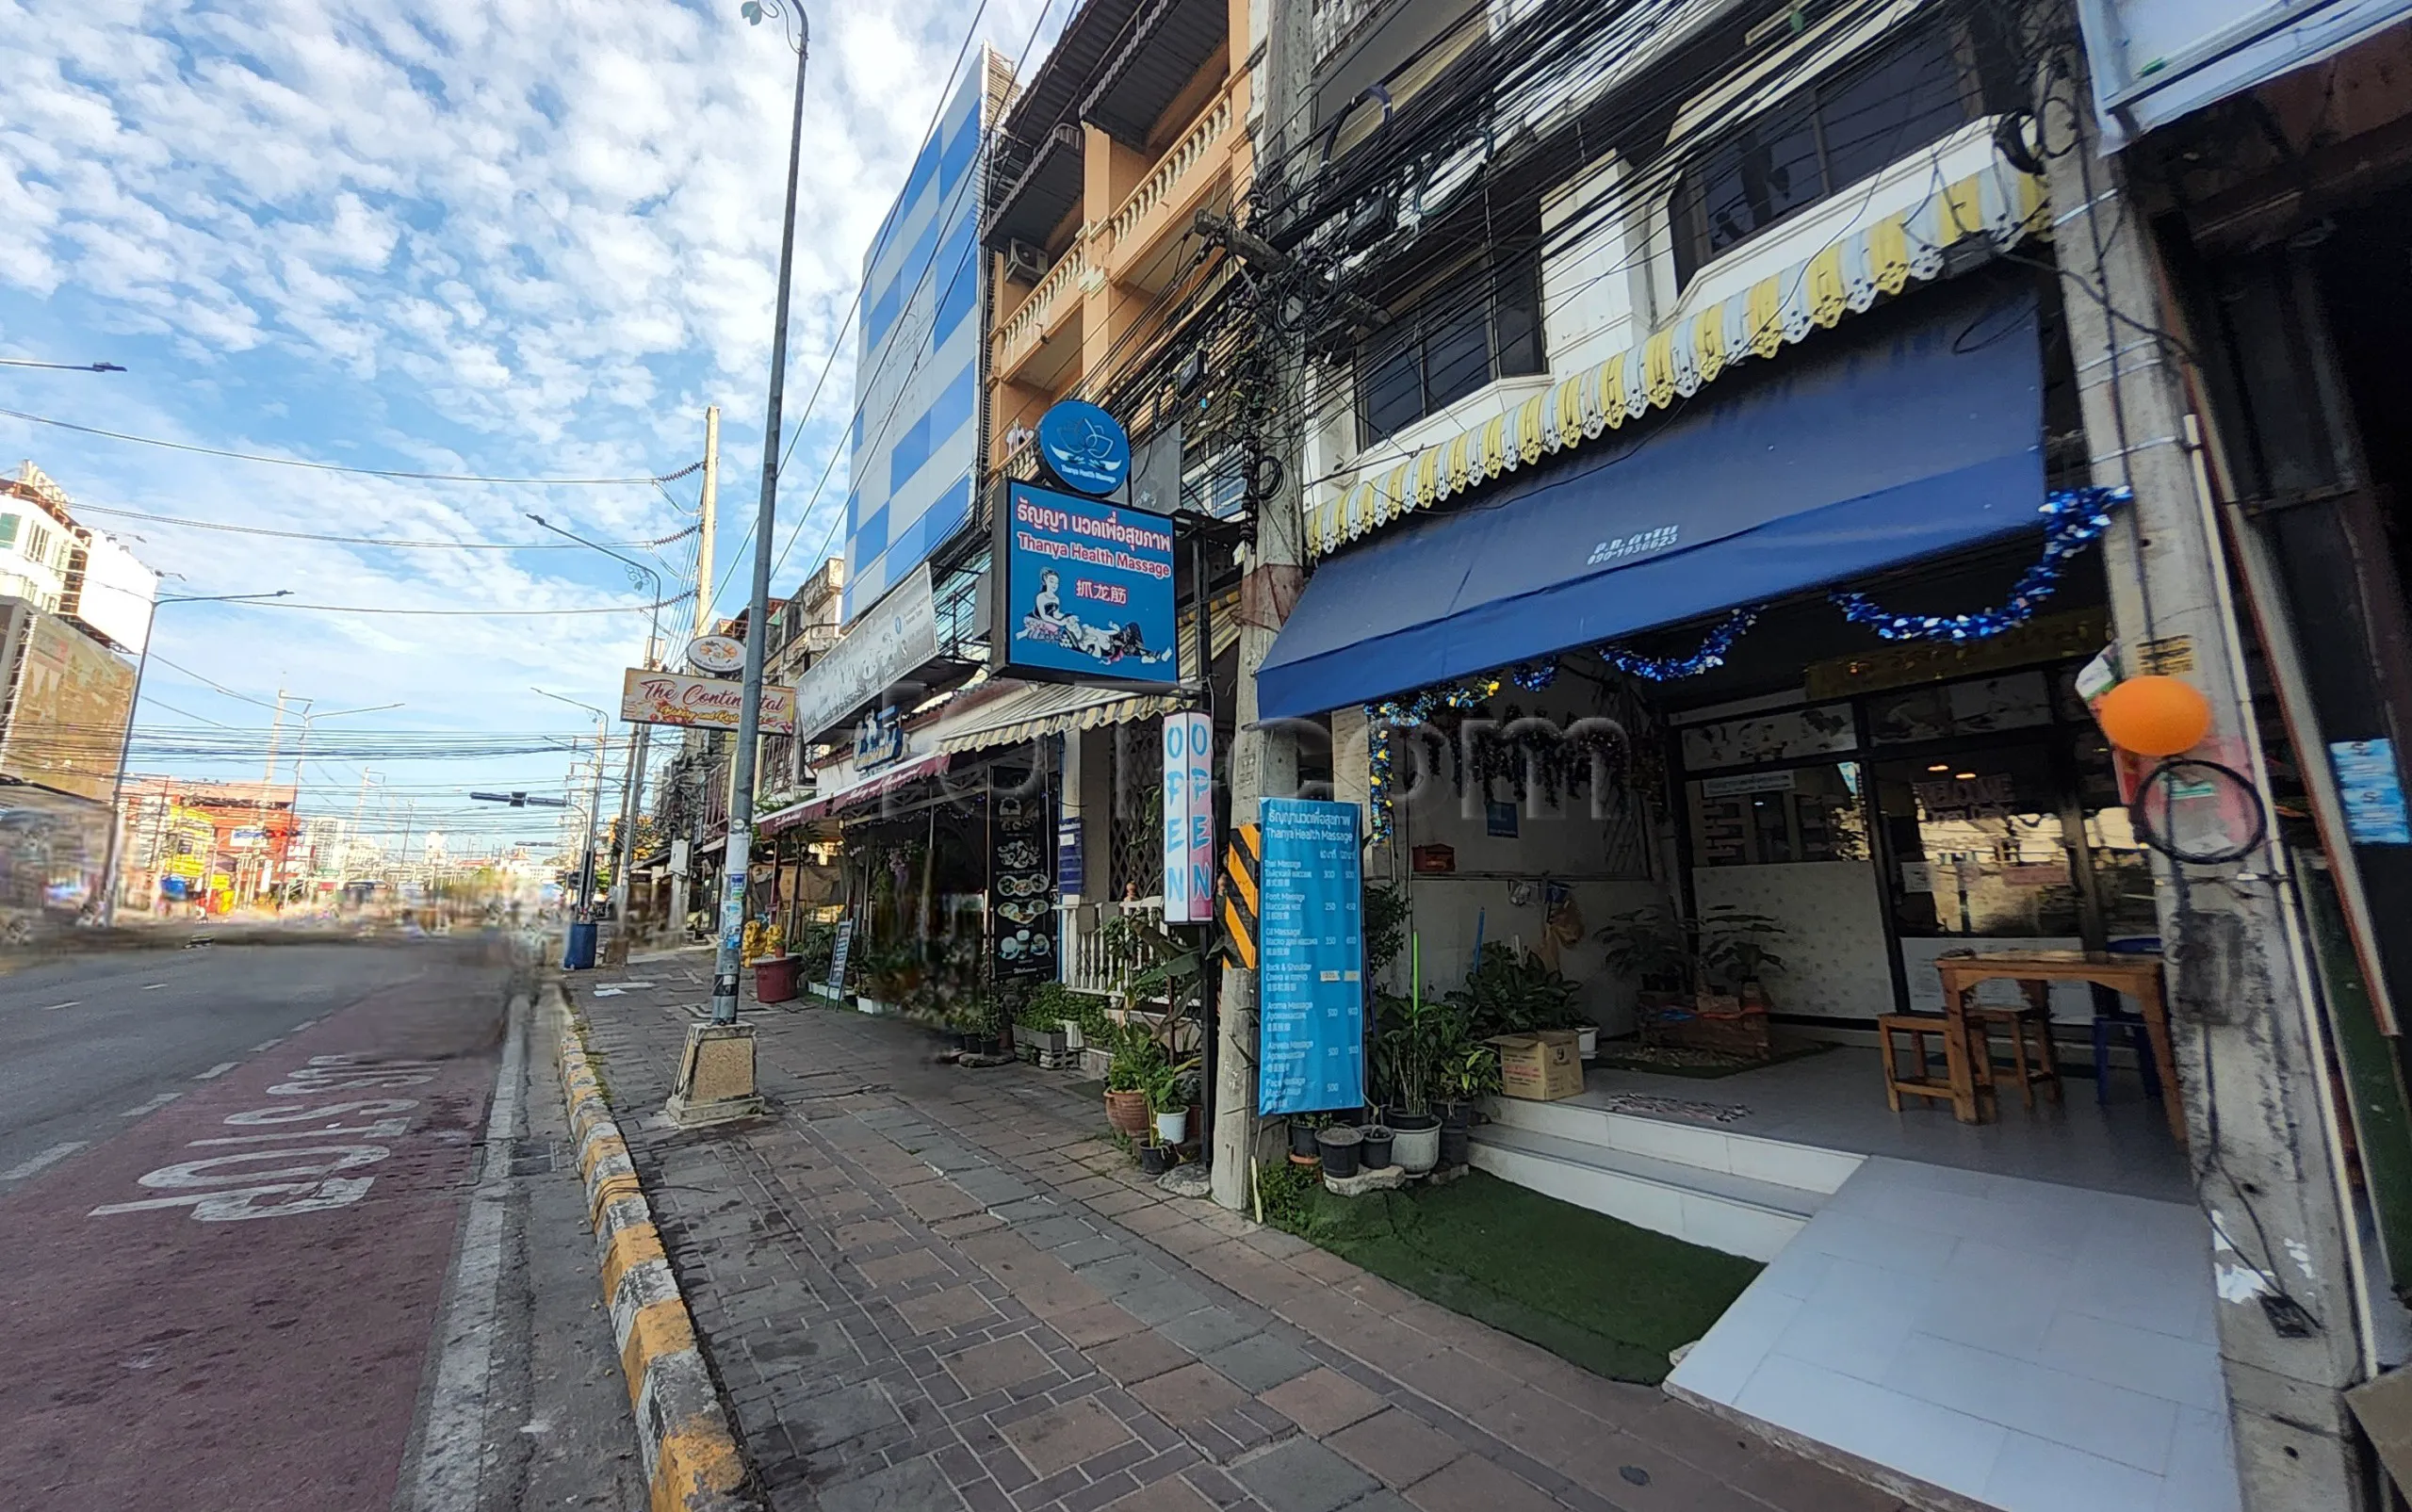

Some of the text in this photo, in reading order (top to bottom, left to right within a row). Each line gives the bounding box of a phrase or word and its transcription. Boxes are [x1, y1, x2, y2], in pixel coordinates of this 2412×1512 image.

[1017, 496, 1171, 553] ธัญญา นวดเพื่อสุขภาพ
[1017, 531, 1172, 580] Thanya Health Massage
[1076, 578, 1128, 605] 抓龙筋
[639, 678, 787, 713] The Contintal
[1166, 725, 1185, 902] OPEN
[1190, 722, 1212, 902] OPEN
[1265, 827, 1353, 844] Thanya Health Massage
[1327, 1082, 1339, 1092] 500
